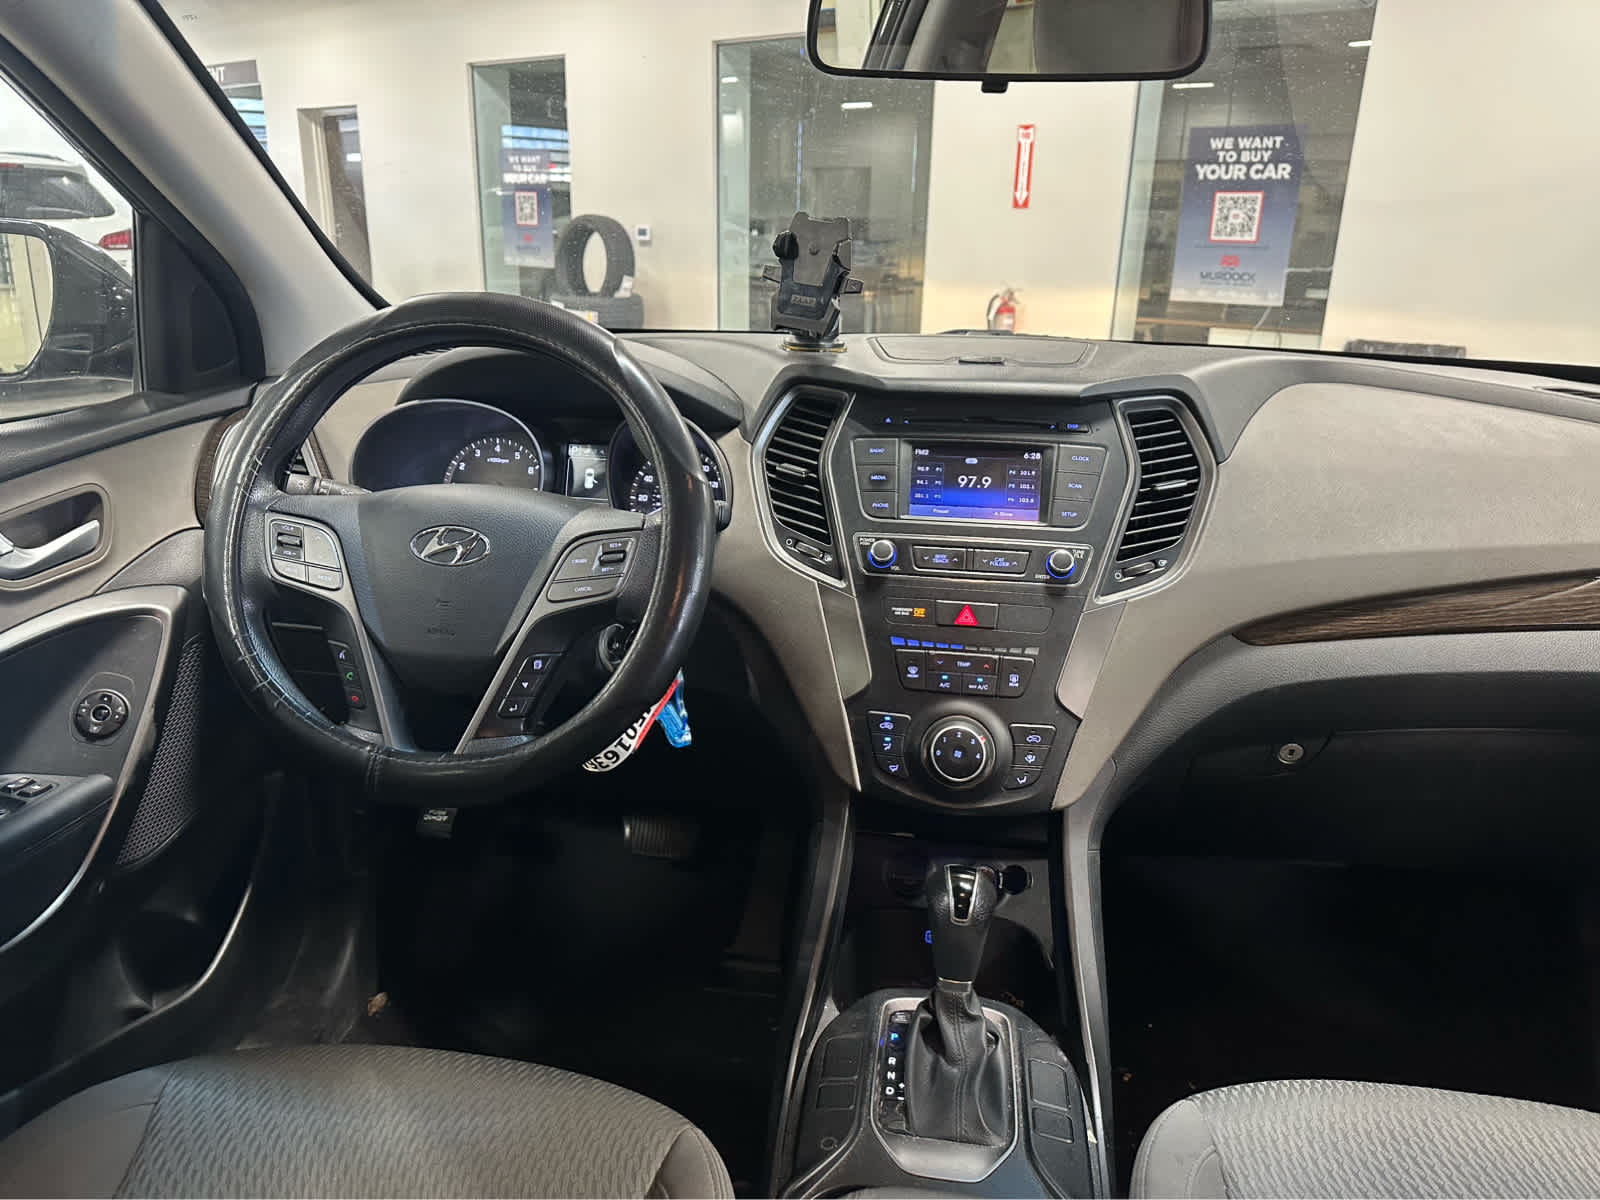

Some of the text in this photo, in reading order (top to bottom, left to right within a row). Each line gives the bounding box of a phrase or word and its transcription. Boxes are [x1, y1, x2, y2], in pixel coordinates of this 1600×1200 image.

[1210, 136, 1284, 149] WE WANT
[1217, 150, 1272, 162] TO BUY
[1195, 164, 1292, 180] YOUR CAR
[1200, 272, 1256, 281] MURDOCK
[459, 462, 466, 470] 2
[958, 475, 992, 488] 97.9
[888, 1057, 896, 1065] R
[887, 1071, 895, 1080] N
[886, 1086, 894, 1095] D
